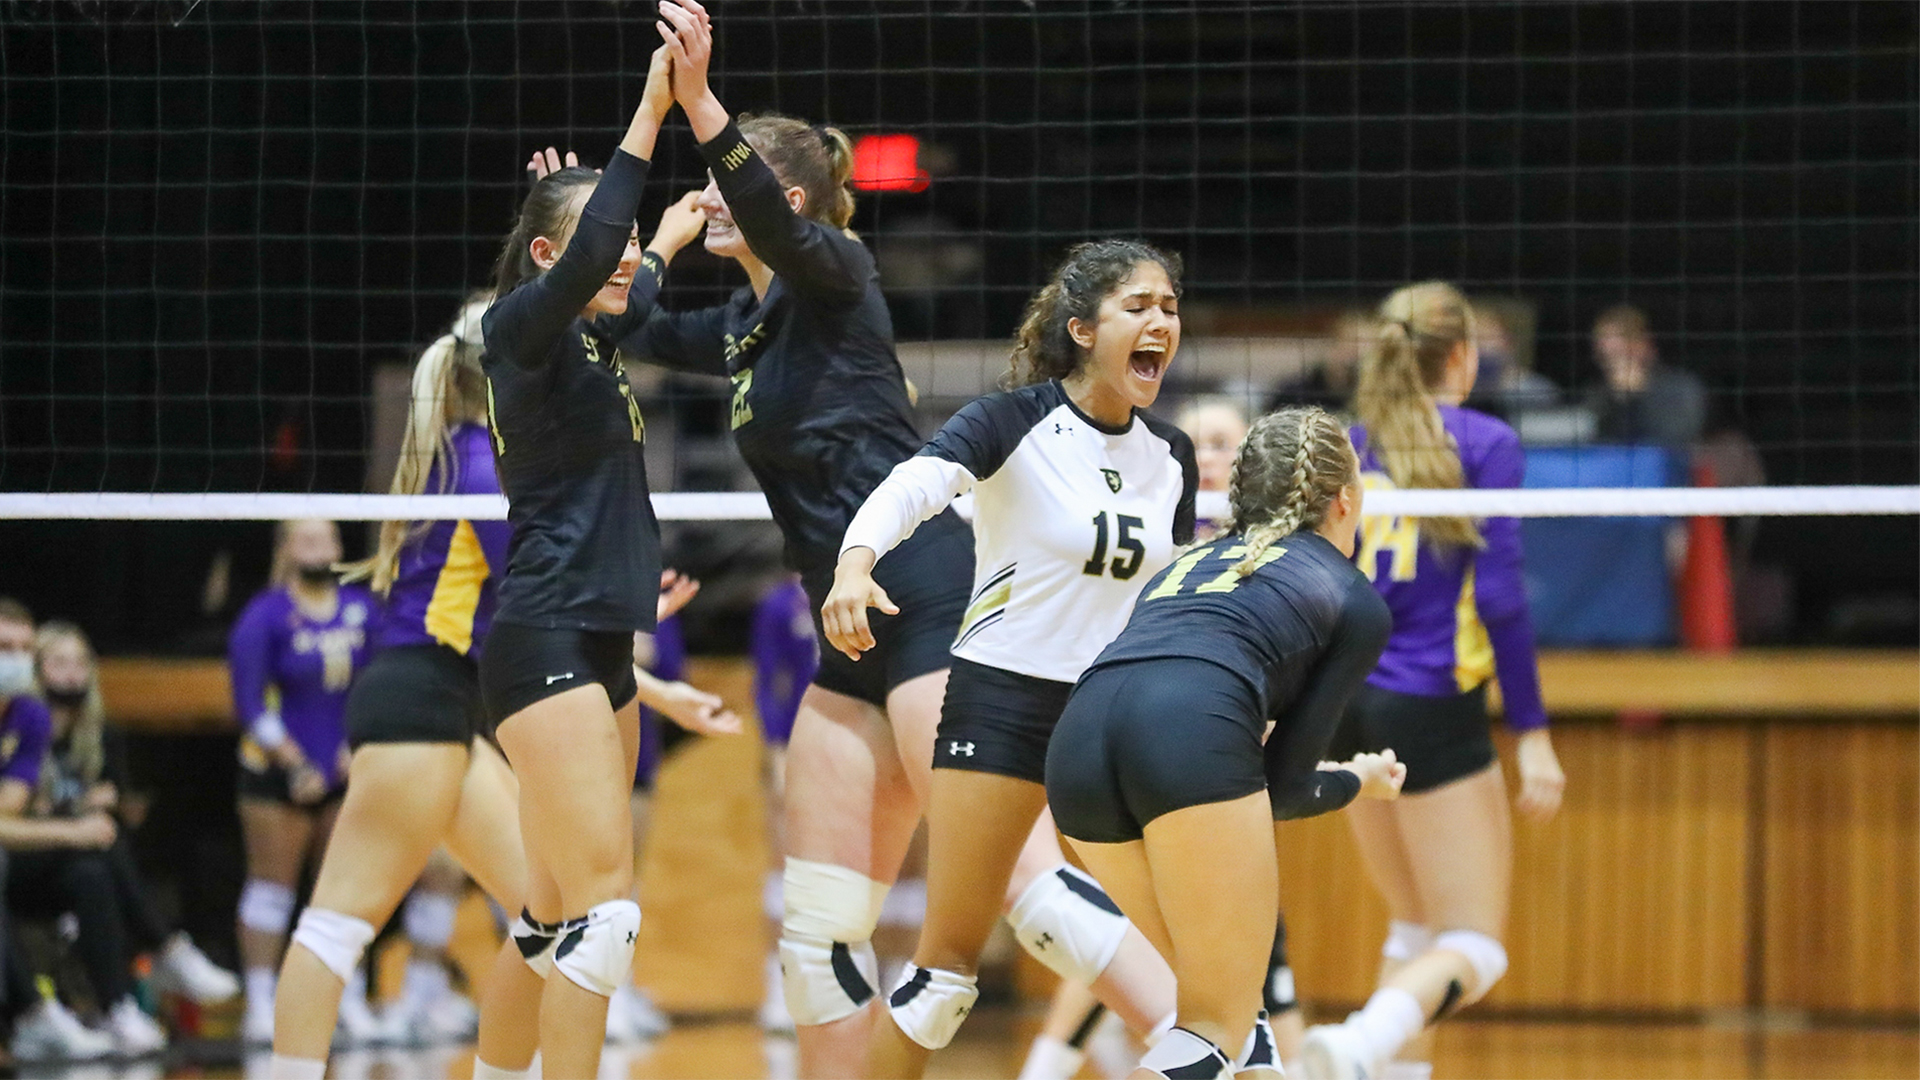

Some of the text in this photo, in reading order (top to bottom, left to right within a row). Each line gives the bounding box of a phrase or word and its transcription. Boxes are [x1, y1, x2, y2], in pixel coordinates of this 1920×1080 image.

[721, 141, 752, 171] YAH!
[1082, 510, 1146, 581] 15
[1145, 546, 1288, 602] 17
